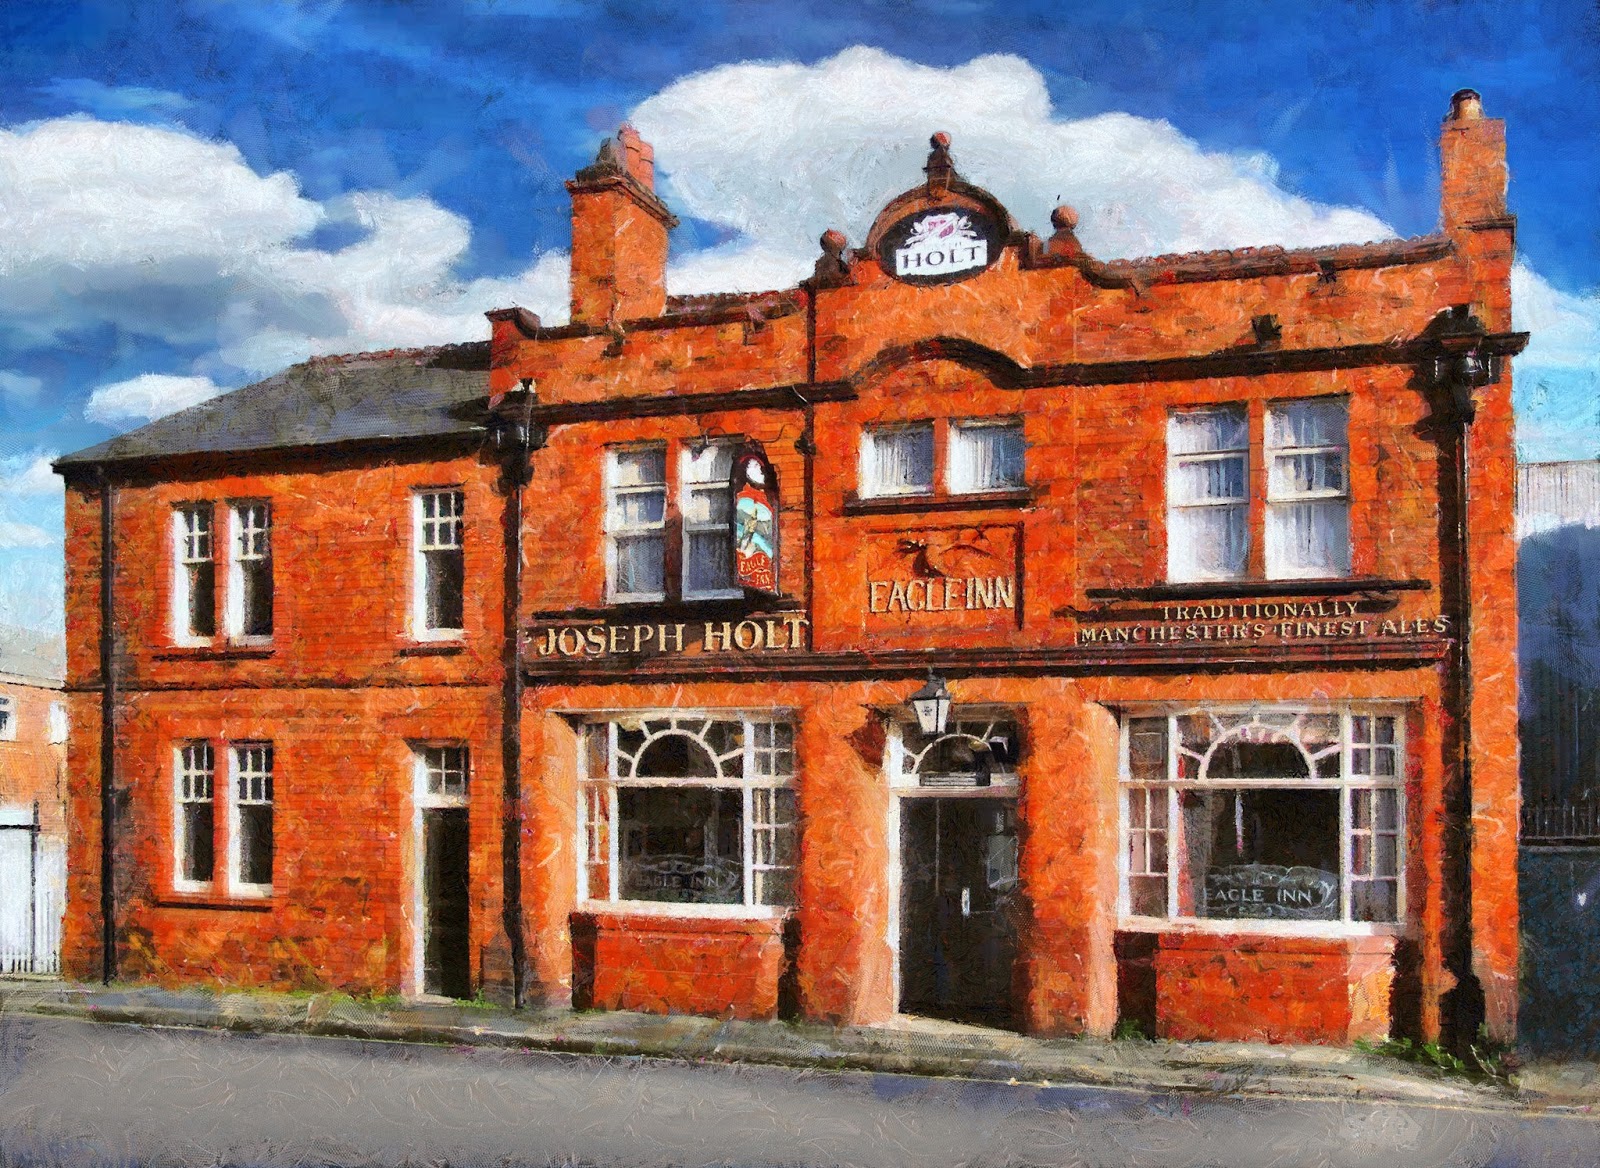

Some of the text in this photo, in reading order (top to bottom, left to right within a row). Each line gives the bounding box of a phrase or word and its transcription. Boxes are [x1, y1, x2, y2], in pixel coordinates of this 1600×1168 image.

[902, 245, 981, 269] HOLT
[869, 575, 1015, 613] EAGLE INN
[1161, 601, 1358, 620] TRADITIONALLY
[537, 616, 809, 656] JOSEPH HOLT
[1280, 619, 1369, 638] FINEST
[1382, 616, 1447, 636] ALES
[1203, 887, 1313, 906] EAGLE INN
